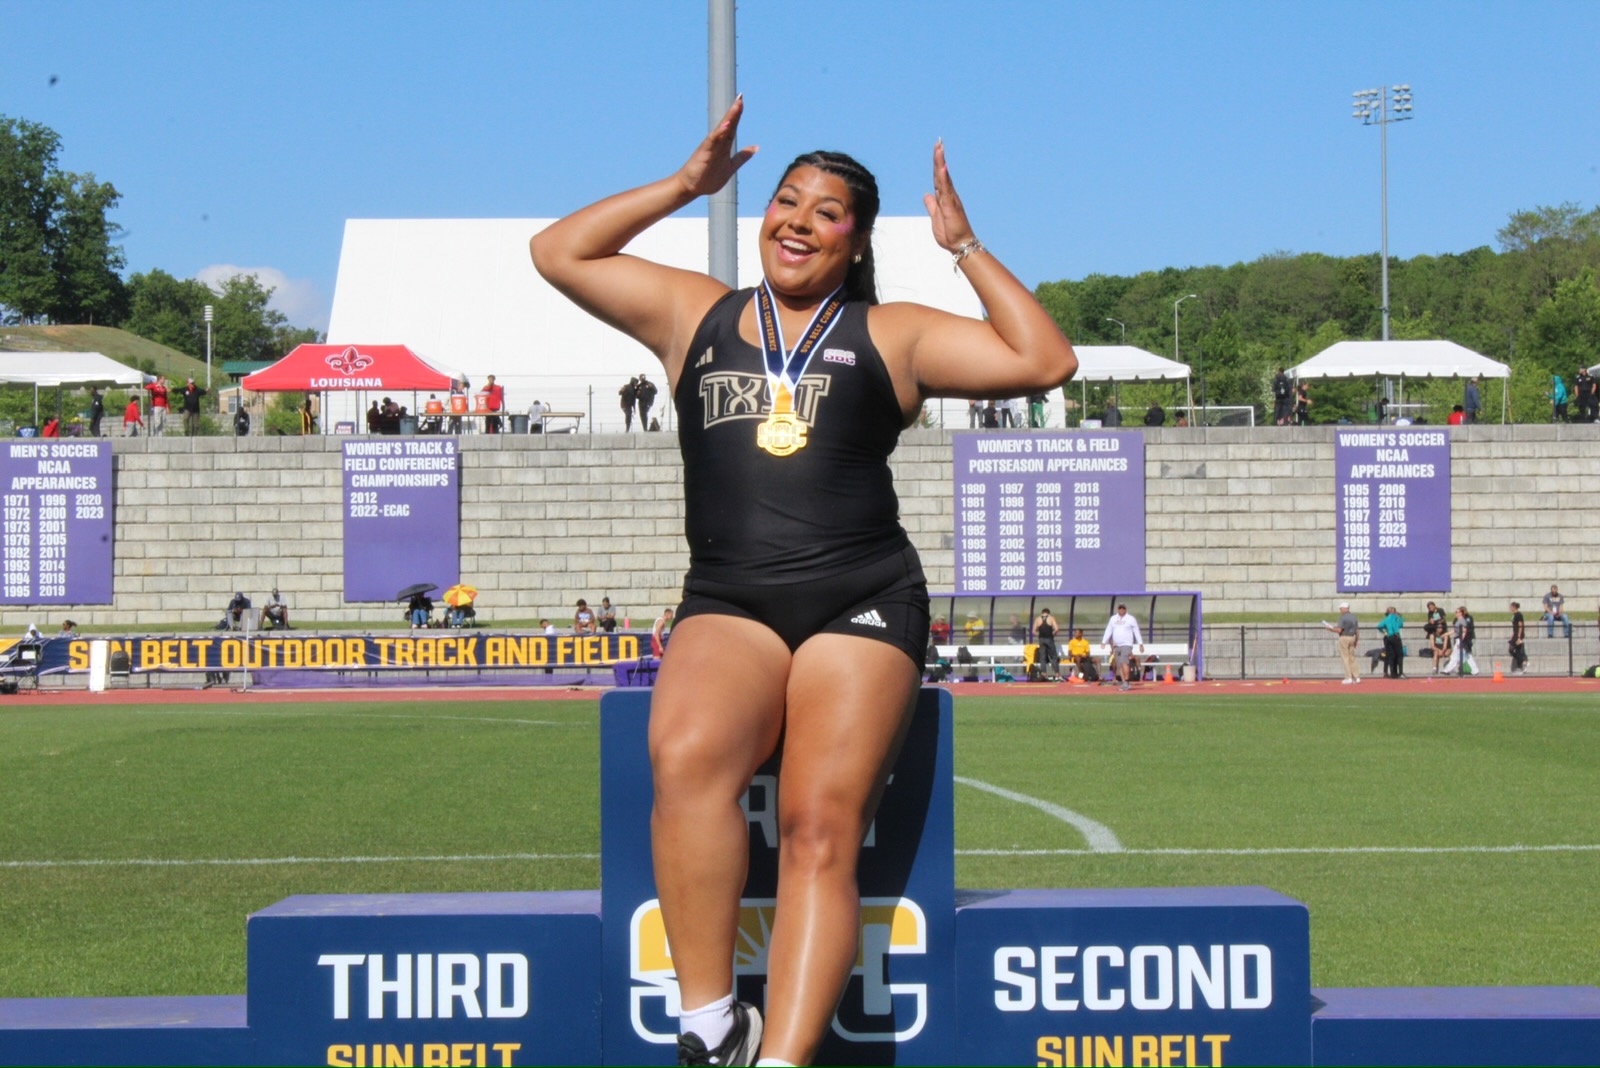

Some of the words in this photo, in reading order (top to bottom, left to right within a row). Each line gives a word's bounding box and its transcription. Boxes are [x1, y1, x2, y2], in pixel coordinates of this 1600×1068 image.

[311, 378, 382, 387] LOUISIANA
[1340, 434, 1396, 446] WOMEN'S
[1399, 433, 1444, 446] SOCCER
[11, 445, 48, 457] MEN'S
[52, 445, 97, 457] SOCCER
[346, 442, 402, 455] WOMEN'S
[405, 442, 442, 454] TRACK
[445, 442, 454, 454] &
[977, 439, 1032, 452] WOMEN'S
[1036, 439, 1073, 452] TRACK
[1077, 439, 1086, 452] &
[1090, 439, 1119, 451] FIELD
[1377, 449, 1408, 461] NCAA
[38, 461, 70, 474] NCAA
[345, 458, 376, 471] FIELD
[380, 458, 454, 470] CONFERENCE
[969, 459, 1043, 473] POSTSEASON
[1047, 458, 1127, 471] APPEARANCES
[1351, 464, 1434, 478] APPEARANCES
[12, 477, 96, 489] APPEARANCES
[352, 474, 448, 487] CHAMPIONSHIPS
[961, 484, 985, 494] 1980
[1000, 483, 1023, 494] 1997
[1074, 482, 1099, 493] 2018
[1344, 484, 1369, 496] 1995
[4, 495, 29, 506] 1971
[40, 494, 66, 506] 1996
[76, 494, 101, 507] 2020
[351, 492, 377, 503] 2012
[962, 497, 984, 507] 1981
[1037, 496, 1059, 507] 2011
[1075, 496, 1099, 506] 2019
[1344, 497, 1369, 508] 1996
[1379, 497, 1405, 508] 2010
[4, 508, 30, 520] 1972
[40, 507, 66, 519] 2000
[76, 507, 103, 519] 2023
[962, 510, 985, 522] 1982
[1000, 510, 1024, 521] 2000
[1037, 510, 1061, 521] 2012
[1075, 510, 1098, 521] 2021
[1344, 509, 1370, 522] 1997
[1379, 509, 1405, 522] 2015
[4, 521, 30, 533] 1973
[40, 521, 65, 532] 2001
[962, 525, 986, 536] 1992
[1000, 525, 1023, 535] 2001
[1075, 524, 1099, 534] 2022
[1344, 523, 1369, 535] 1998
[1379, 523, 1406, 534] 2023
[4, 534, 30, 546] 1976
[40, 534, 66, 545] 2005
[1037, 538, 1061, 549] 2014
[1075, 538, 1100, 548] 2023
[1344, 536, 1370, 547] 1999
[1379, 536, 1406, 547] 2024
[4, 547, 30, 558] 1992
[40, 547, 65, 558] 2011
[962, 552, 986, 563] 1994
[1000, 552, 1025, 562] 2004
[1037, 552, 1062, 562] 2015
[1344, 549, 1370, 560] 2002
[4, 560, 30, 571] 1993
[40, 560, 65, 571] 2014
[963, 566, 986, 576] 1995
[1037, 565, 1062, 576] 2016
[1344, 561, 1370, 573] 2004
[4, 573, 30, 584] 1994
[40, 573, 65, 584] 2018
[1344, 574, 1370, 586] 2007
[1001, 579, 1025, 590] 2007
[1038, 579, 1062, 590] 2017
[4, 586, 30, 597] 1995
[40, 585, 65, 596] 2019
[851, 617, 887, 628] adidas
[69, 640, 132, 669] SN
[141, 640, 213, 669] BELT
[221, 639, 365, 668] OUTDOOR
[374, 638, 477, 666] TRACK
[485, 637, 548, 665] AND
[556, 636, 638, 664] FIELD
[994, 945, 1272, 1011] SECOND
[317, 953, 528, 1019] THIRD
[327, 1044, 413, 1067] SUN
[423, 1044, 521, 1067] BELT
[1037, 1035, 1123, 1067] SUN
[1132, 1035, 1231, 1067] BELT
